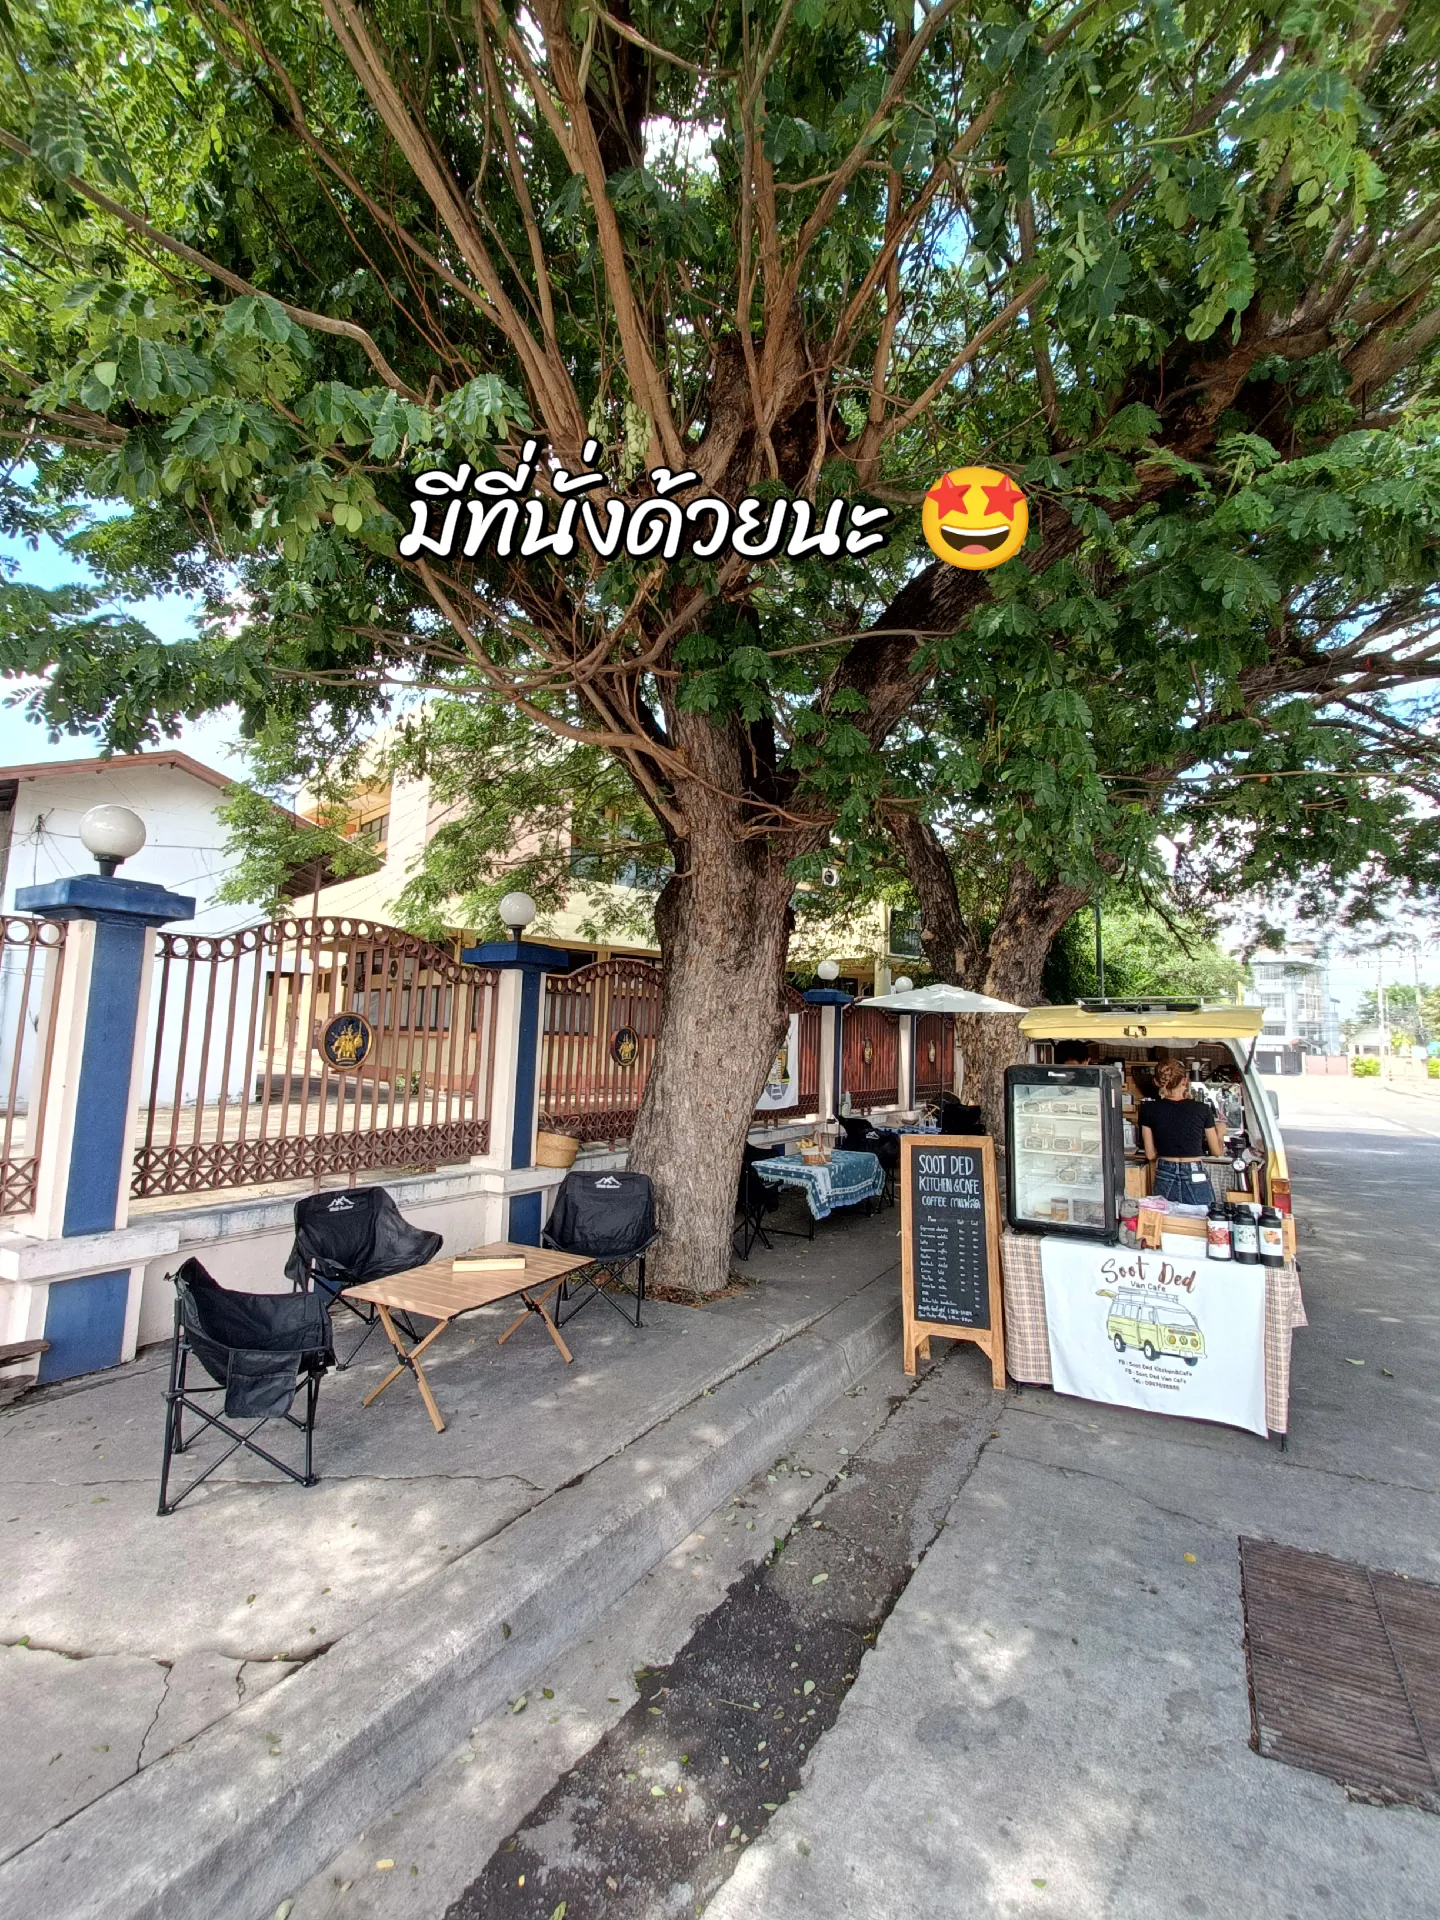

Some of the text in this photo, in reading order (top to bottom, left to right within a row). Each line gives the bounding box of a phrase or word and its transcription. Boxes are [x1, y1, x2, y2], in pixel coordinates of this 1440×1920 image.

[918, 1154, 974, 1176] SOOT DED
[921, 1195, 947, 1208] COFFEE
[1100, 1255, 1197, 1294] Soot Ded
[1130, 1280, 1166, 1292] Van Cafe
